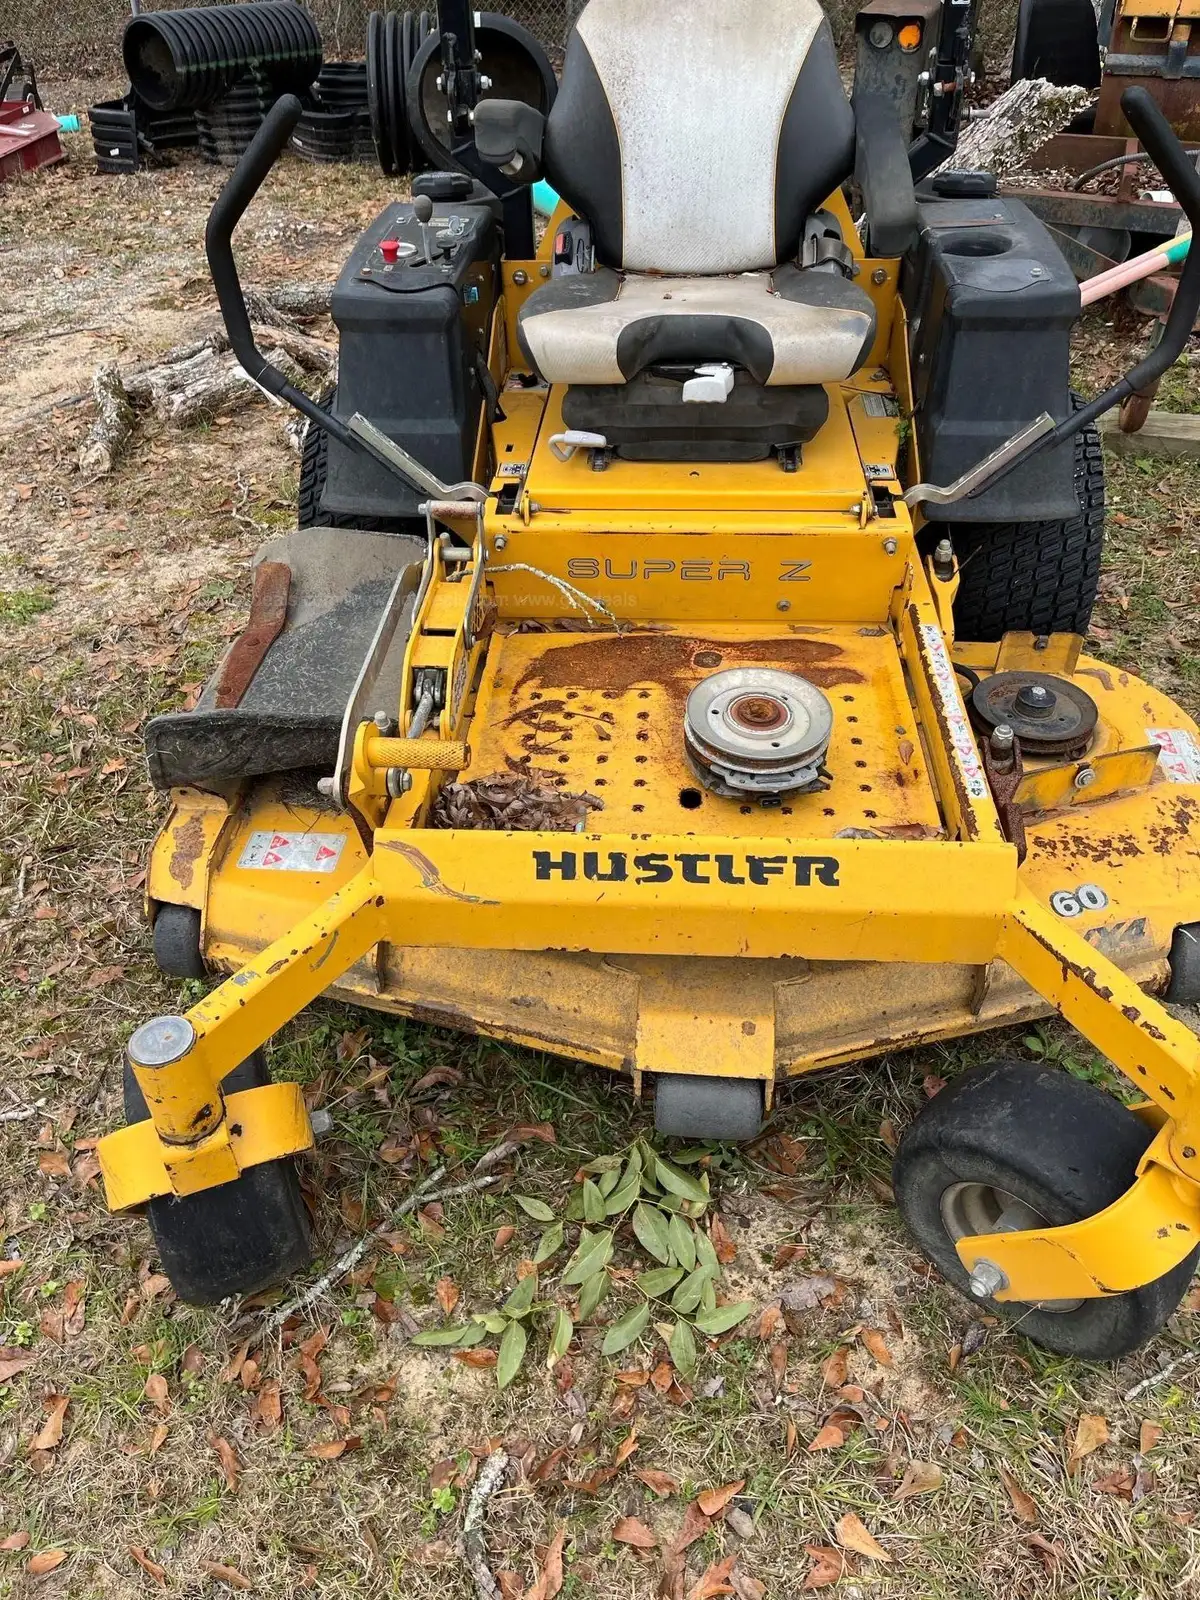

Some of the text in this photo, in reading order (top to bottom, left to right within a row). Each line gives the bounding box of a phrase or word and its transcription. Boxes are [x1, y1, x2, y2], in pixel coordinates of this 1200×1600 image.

[567, 557, 813, 582] SUPER Z
[532, 850, 840, 887] HUSTLER
[1049, 883, 1109, 918] 60
